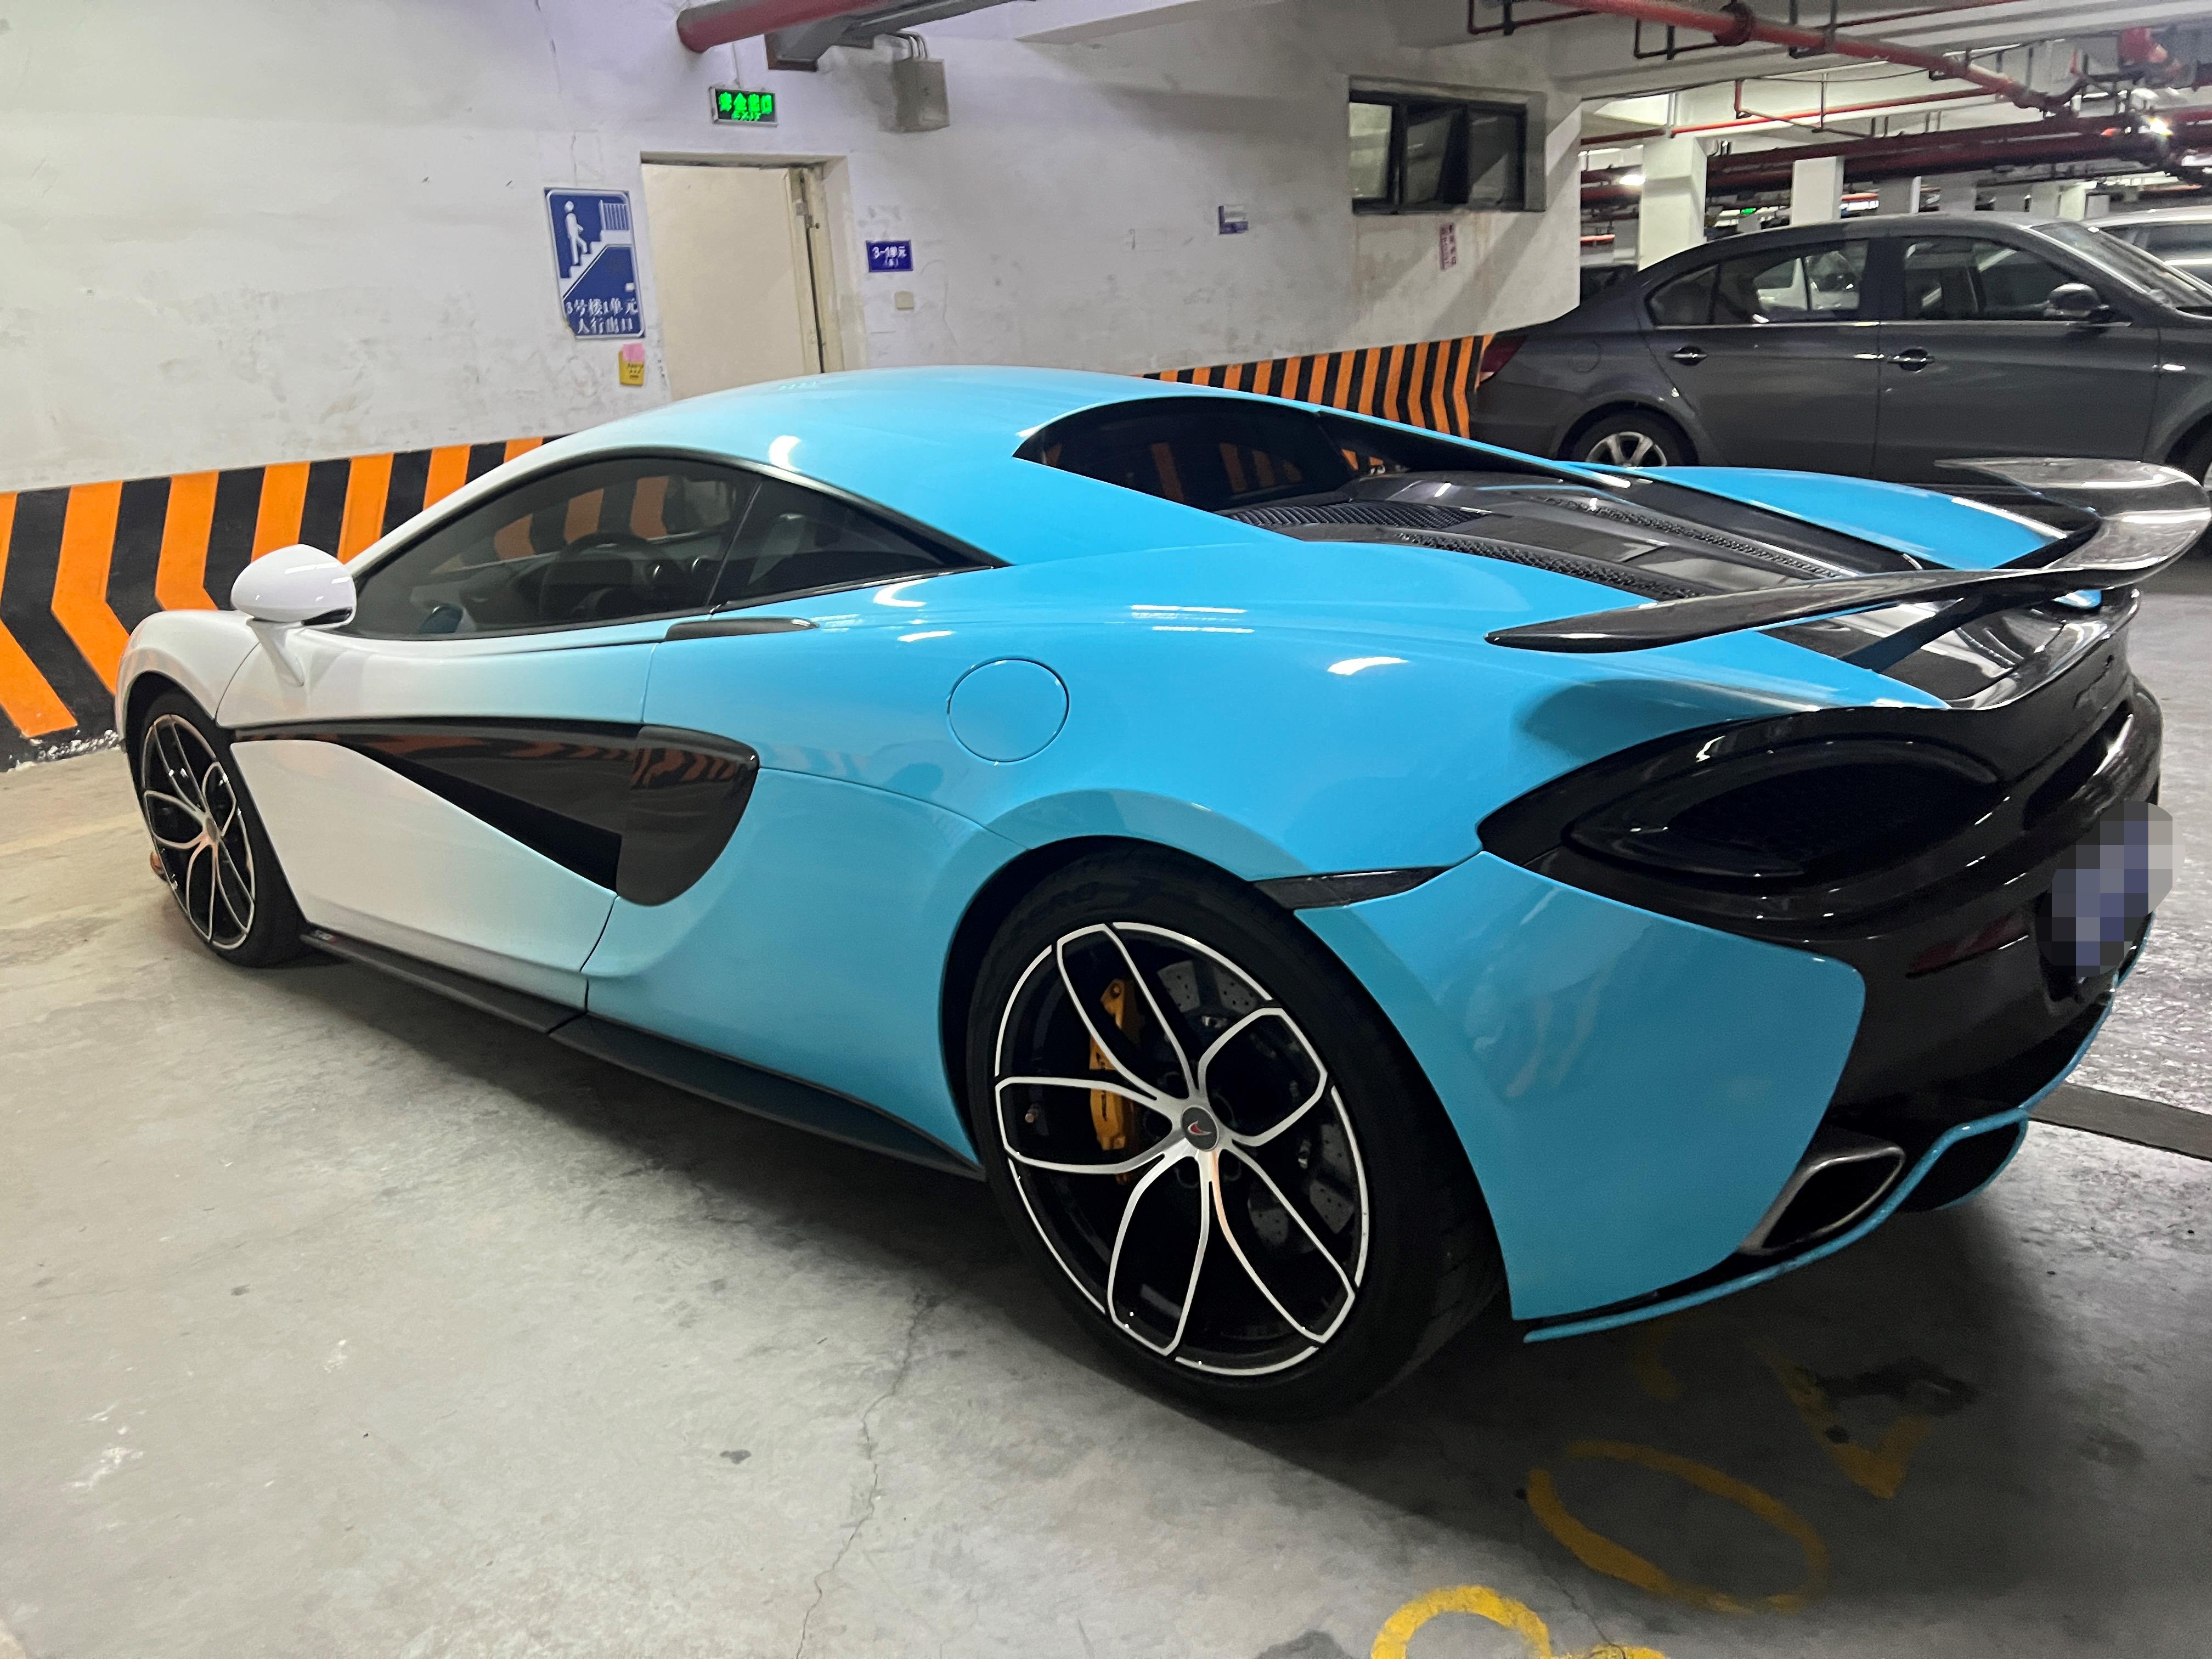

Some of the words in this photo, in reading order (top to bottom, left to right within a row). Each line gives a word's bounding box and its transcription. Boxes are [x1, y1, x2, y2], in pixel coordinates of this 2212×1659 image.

[718, 91, 773, 114] 安全出口
[732, 110, 761, 121] EXIT
[566, 297, 639, 318] 3号楼1单元
[577, 317, 633, 334] 人行出口
